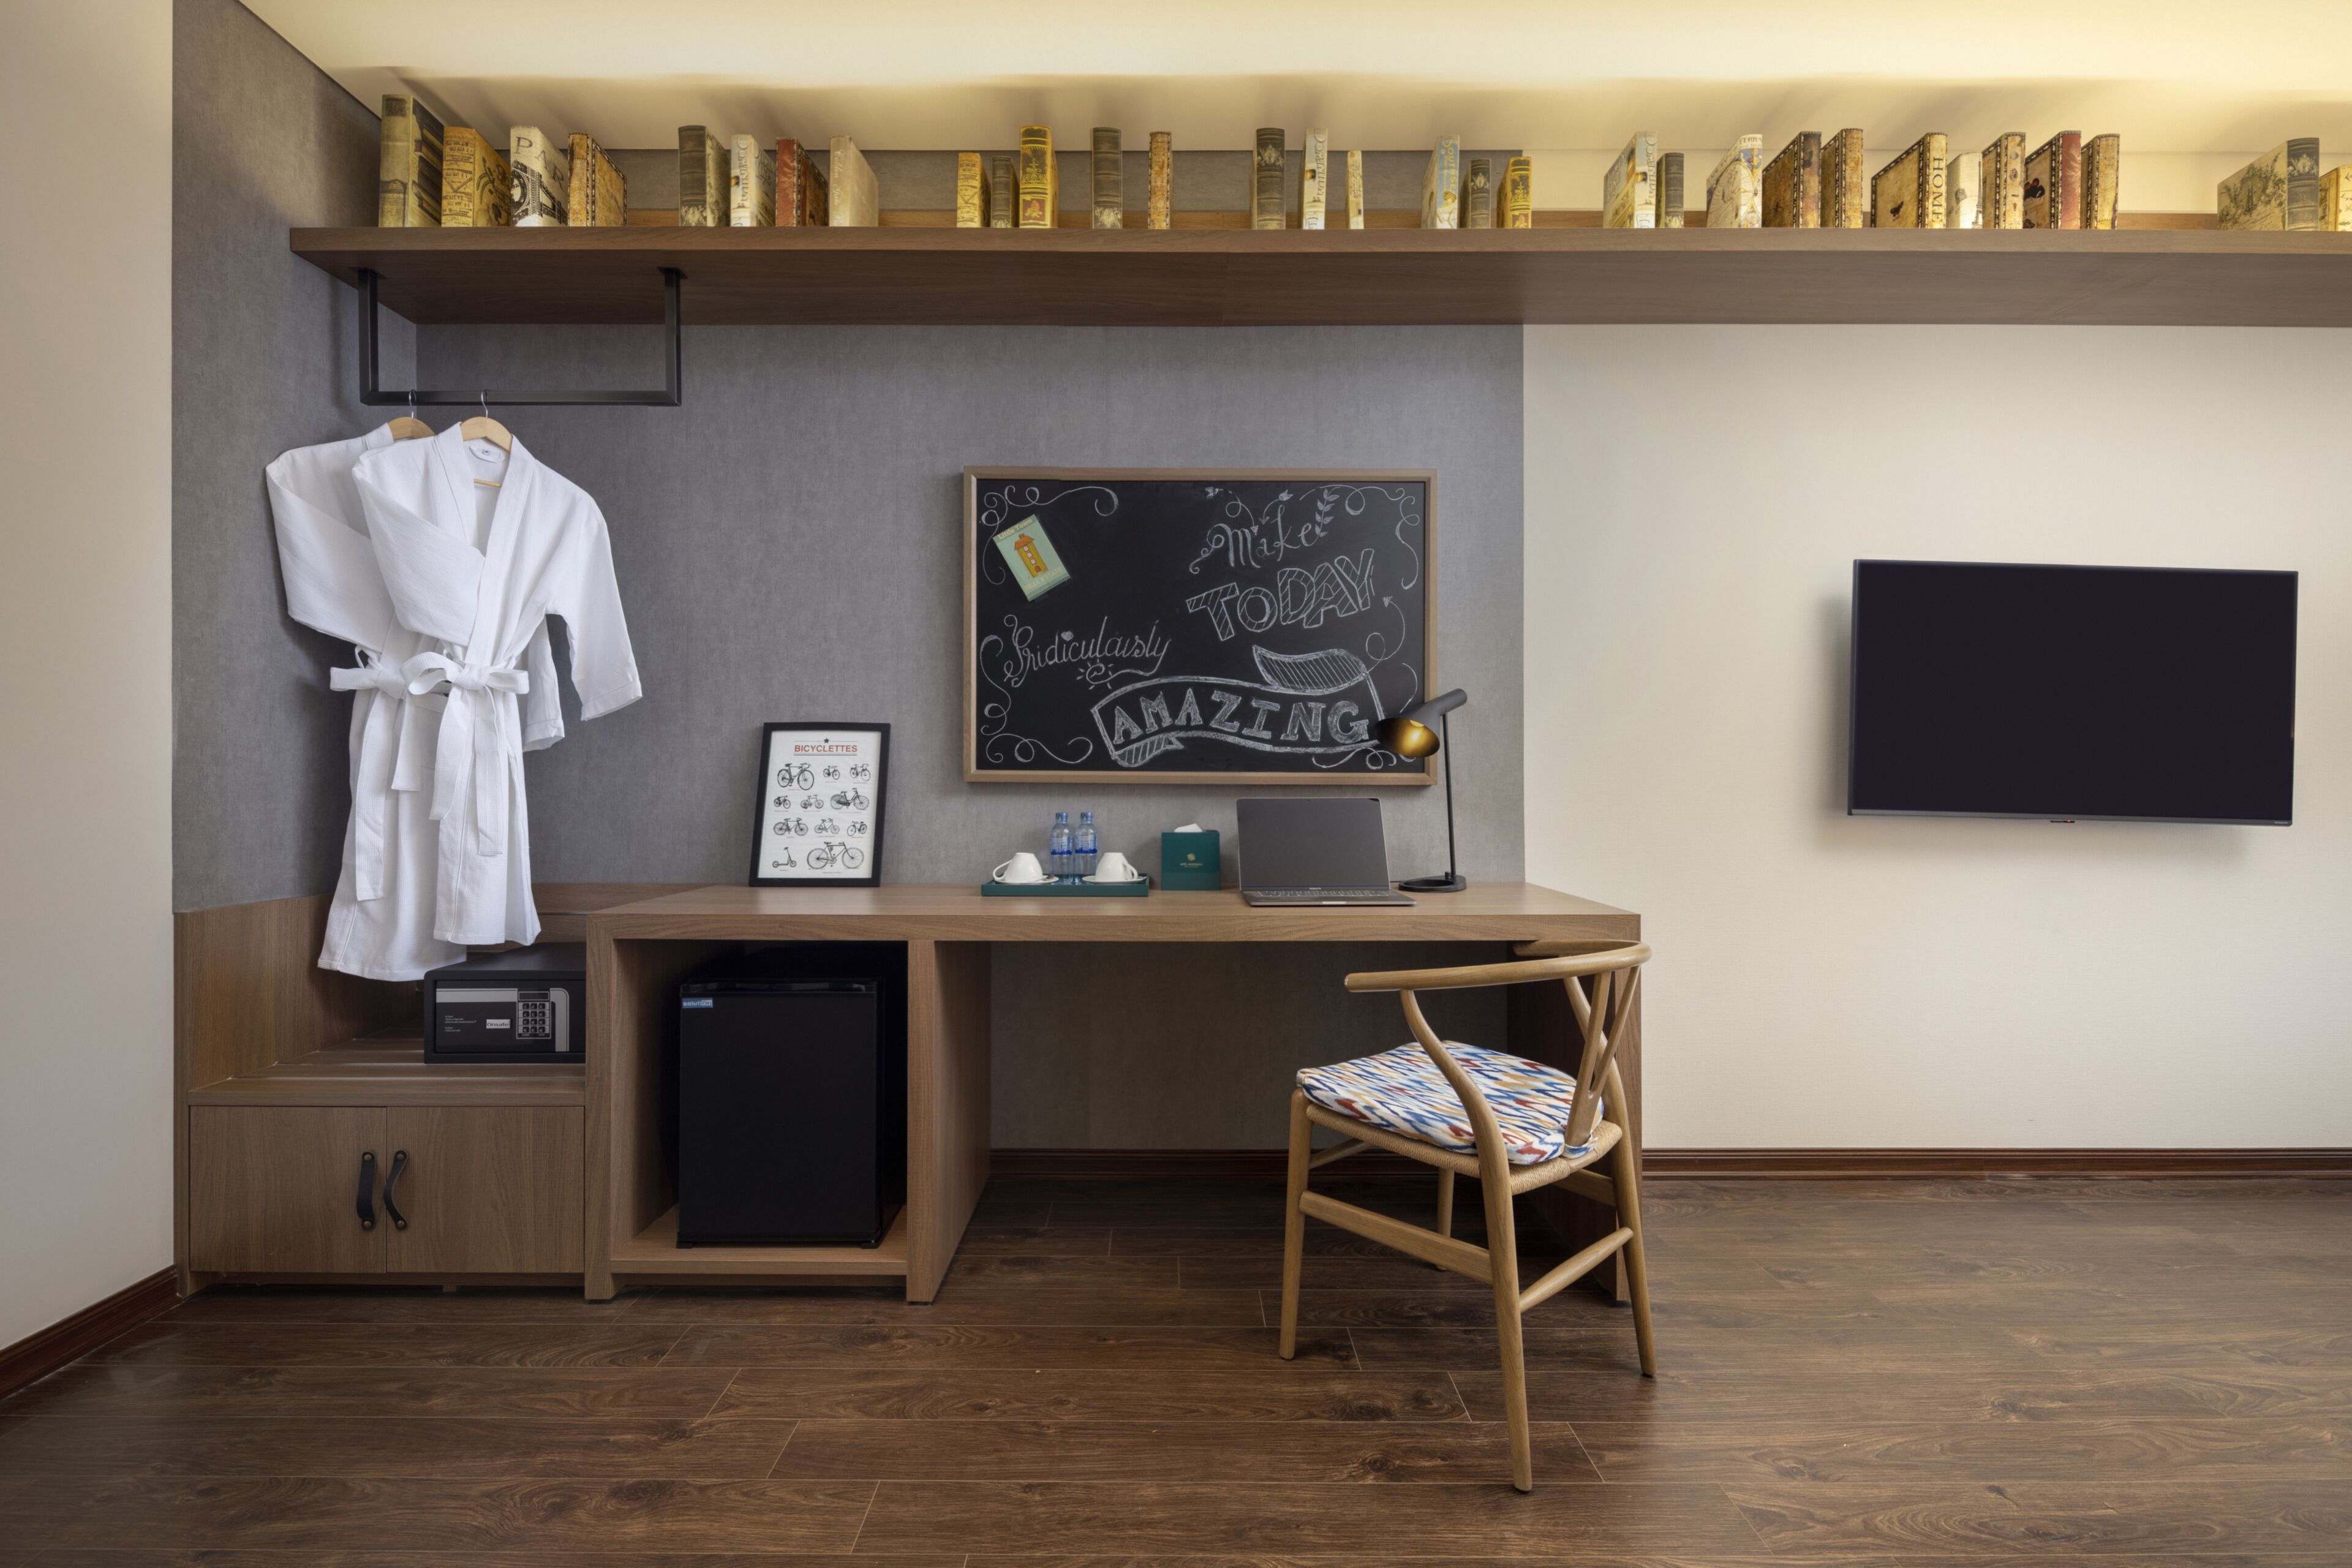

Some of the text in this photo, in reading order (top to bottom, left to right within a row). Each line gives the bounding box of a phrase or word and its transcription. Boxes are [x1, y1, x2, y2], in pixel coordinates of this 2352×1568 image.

[1932, 157, 1944, 223] HOME
[998, 518, 1033, 540] Little Town
[1189, 504, 1319, 574] Make
[1186, 548, 1374, 641] TODAY
[1113, 687, 1370, 744] AMAZING
